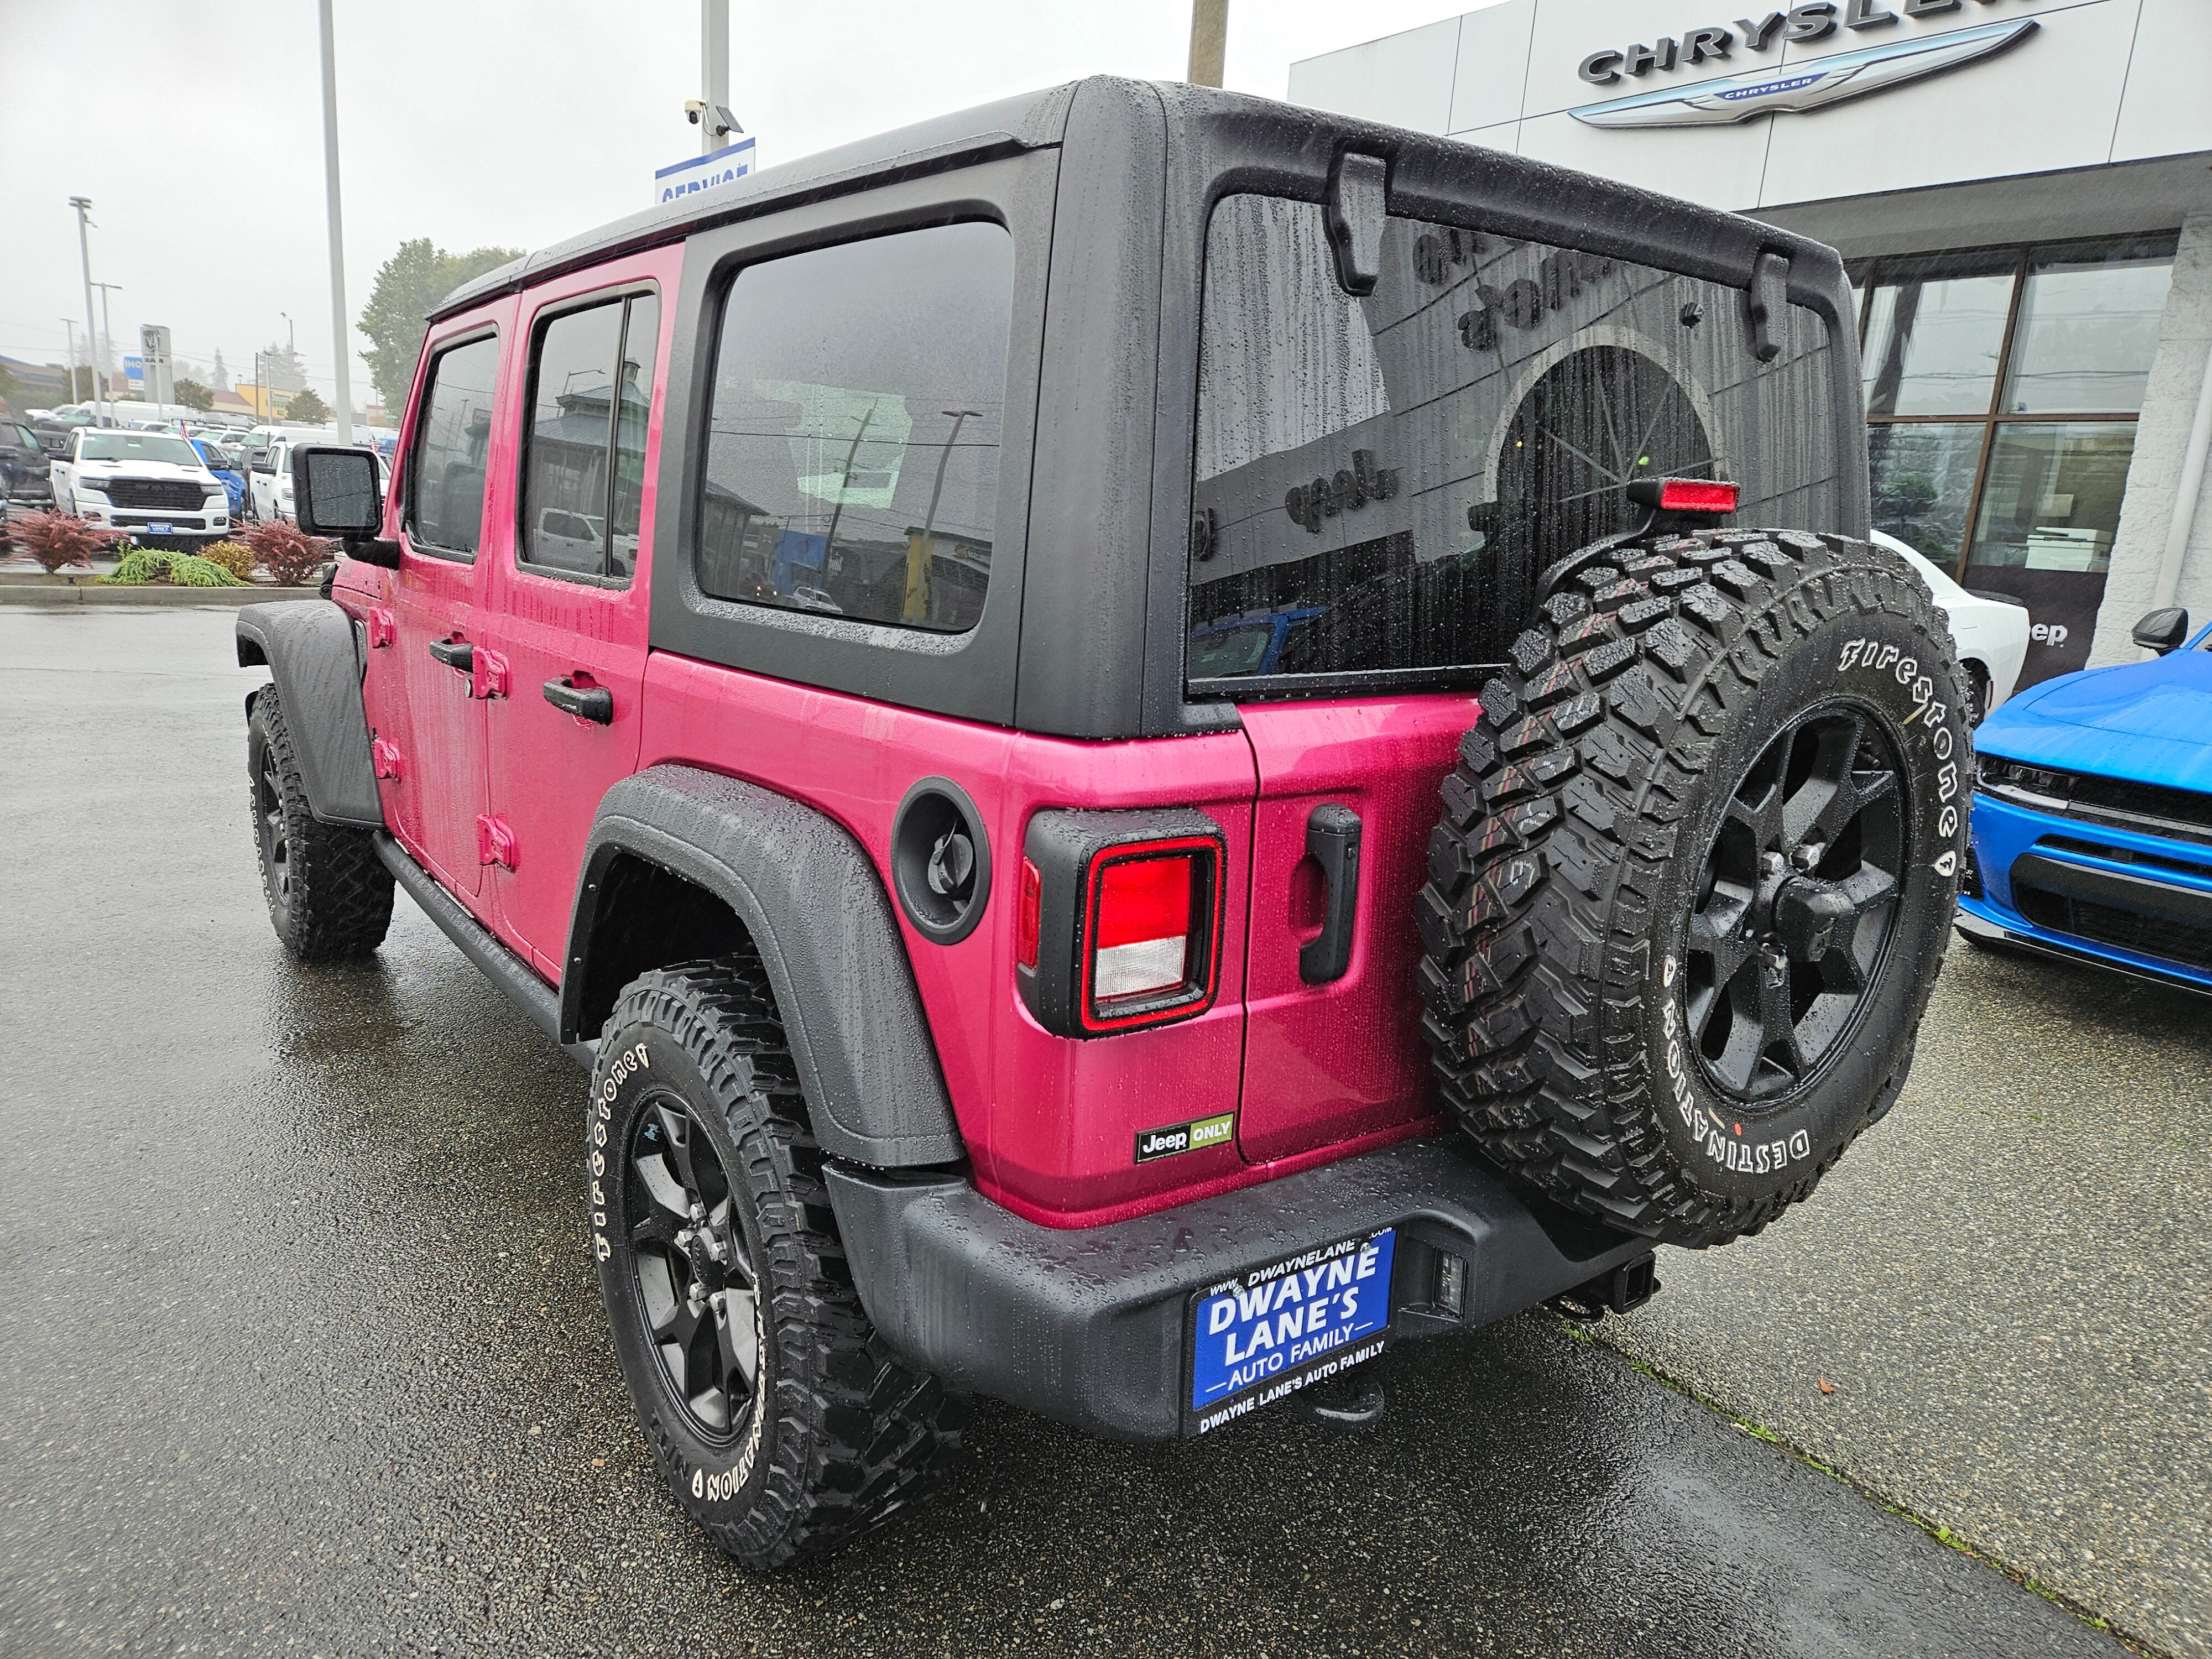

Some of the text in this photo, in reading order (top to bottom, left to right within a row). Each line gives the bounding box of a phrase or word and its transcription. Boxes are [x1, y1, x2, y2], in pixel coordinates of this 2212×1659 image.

[1724, 77, 1813, 99] CHRYSLER
[124, 359, 143, 369] IHO
[2031, 623, 2068, 648] ep
[1838, 638, 1958, 838] Firestone
[1661, 997, 1811, 1174] DESTINATION
[1142, 1121, 1231, 1153] Jeep ONLY
[1209, 1246, 1380, 1335] DWAYNE
[1225, 1286, 1359, 1366] LANE'S
[1200, 1340, 1385, 1434] DWAYNE LANE'S AUTO FAMILY
[1228, 1323, 1354, 1391] AUTO FAMILY
